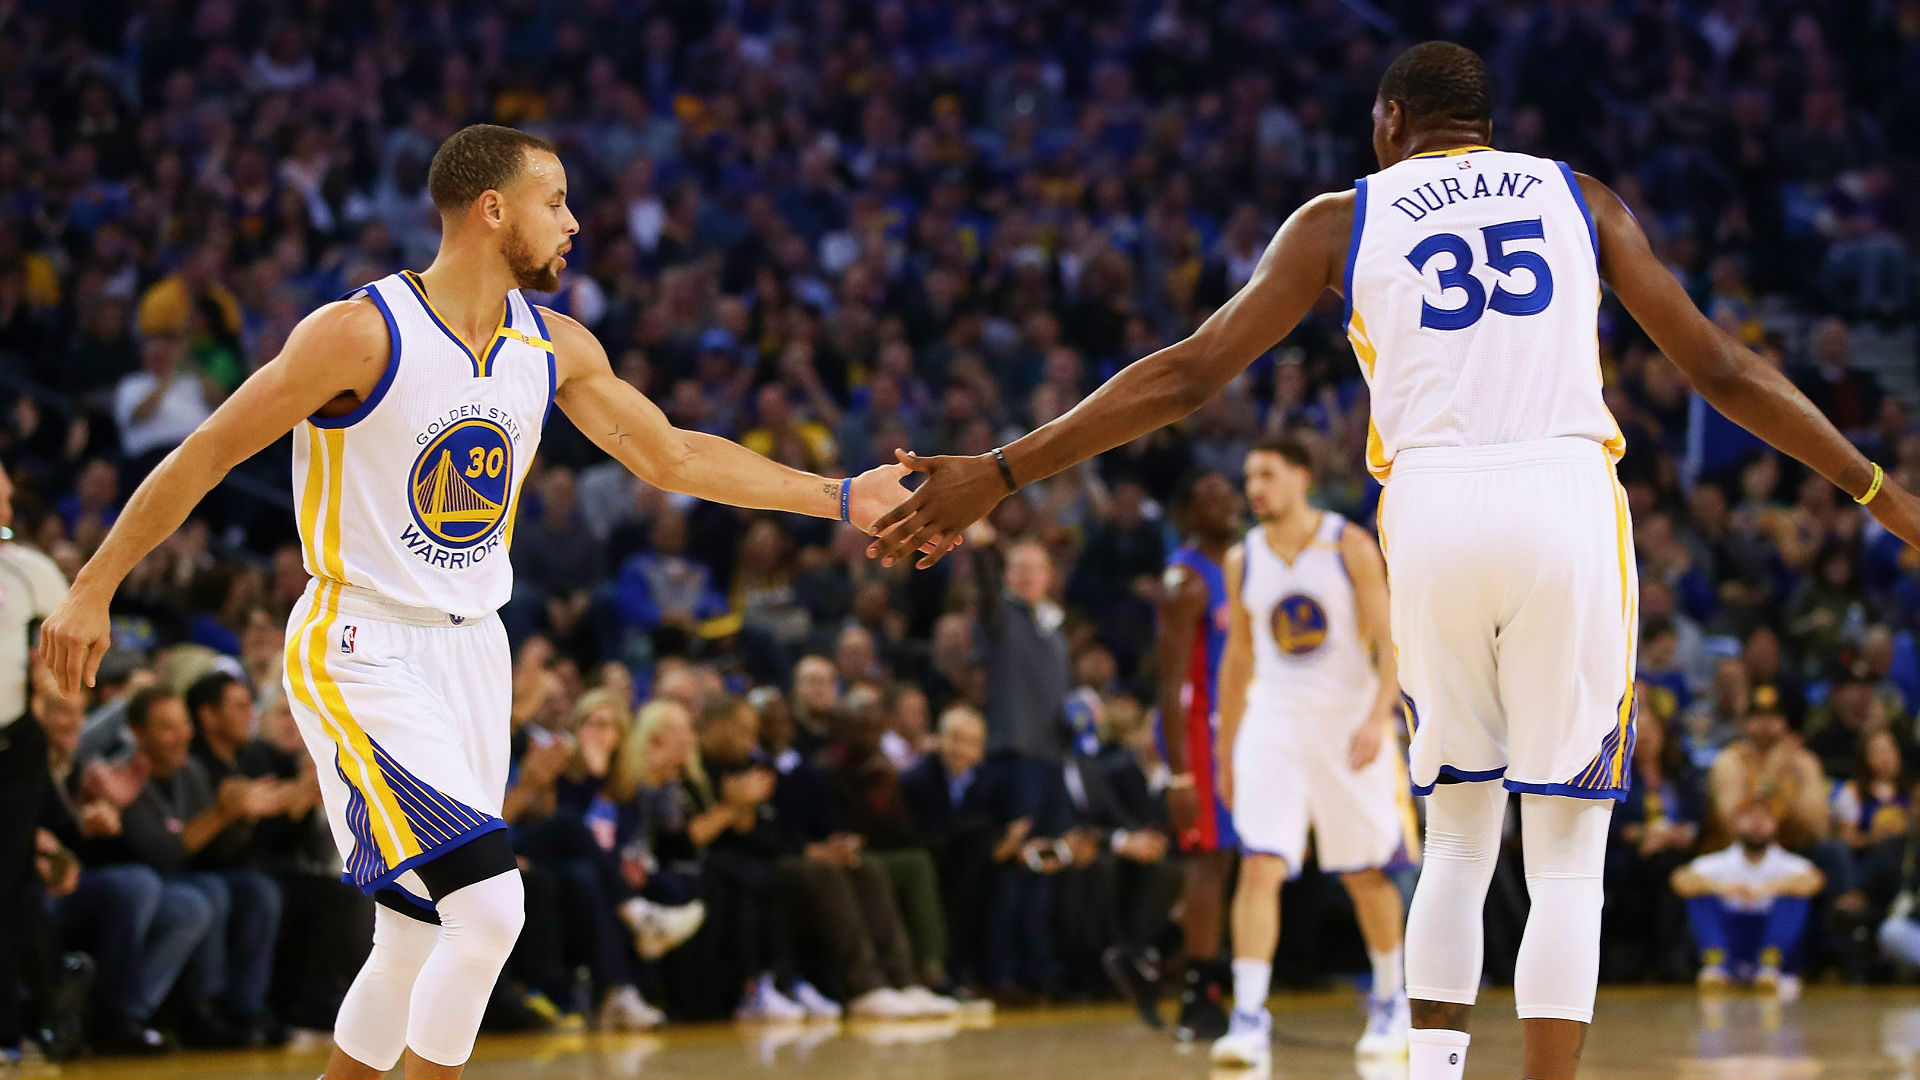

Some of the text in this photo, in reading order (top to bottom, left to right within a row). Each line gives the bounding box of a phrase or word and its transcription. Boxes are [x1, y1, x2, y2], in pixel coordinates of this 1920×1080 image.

[1391, 172, 1543, 222] DURANT
[1404, 215, 1553, 331] 35
[416, 404, 521, 445] GOLDEN STATE
[465, 446, 504, 478] 30
[400, 522, 507, 569] WARRIORS
